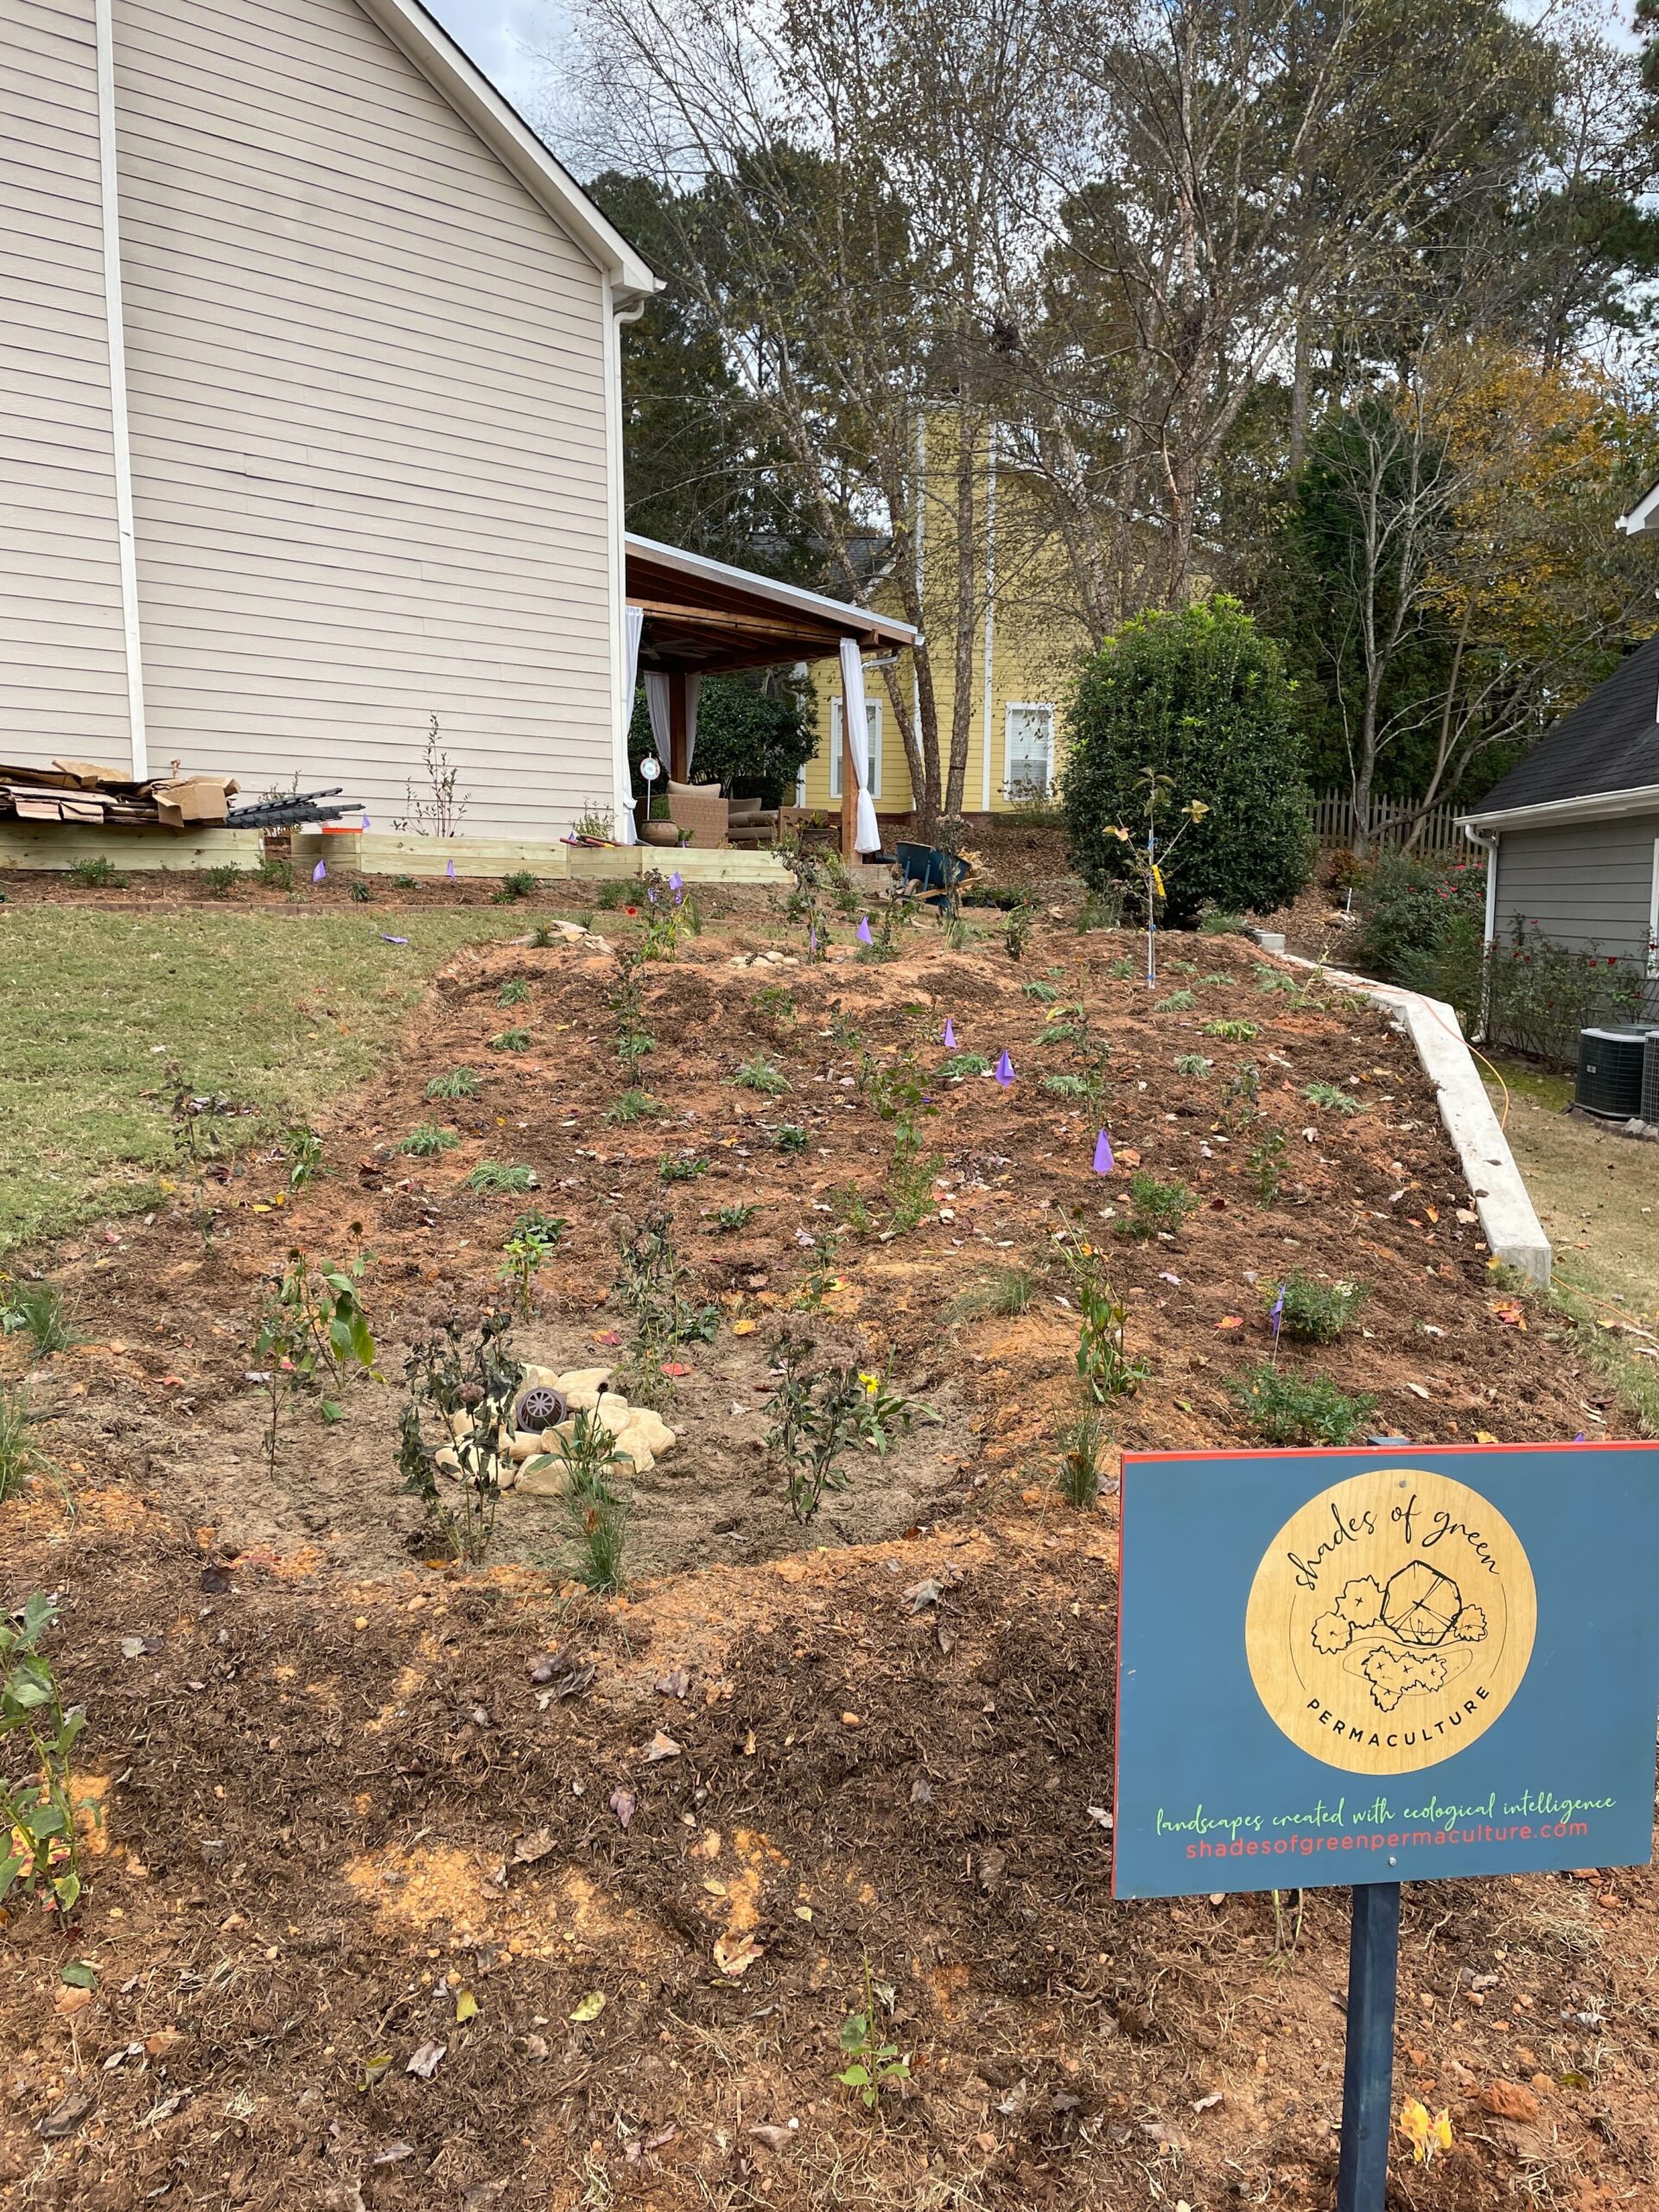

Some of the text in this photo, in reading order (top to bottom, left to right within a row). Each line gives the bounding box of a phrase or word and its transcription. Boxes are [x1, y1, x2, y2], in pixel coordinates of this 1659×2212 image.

[1287, 1494, 1500, 1592] shades of green
[1306, 1685, 1490, 1748] PERMACULTURE
[1155, 1789, 1617, 1840] landscapes created with ecological intelligence
[1186, 1821, 1588, 1859] shadesofgreenpermaculture.com
